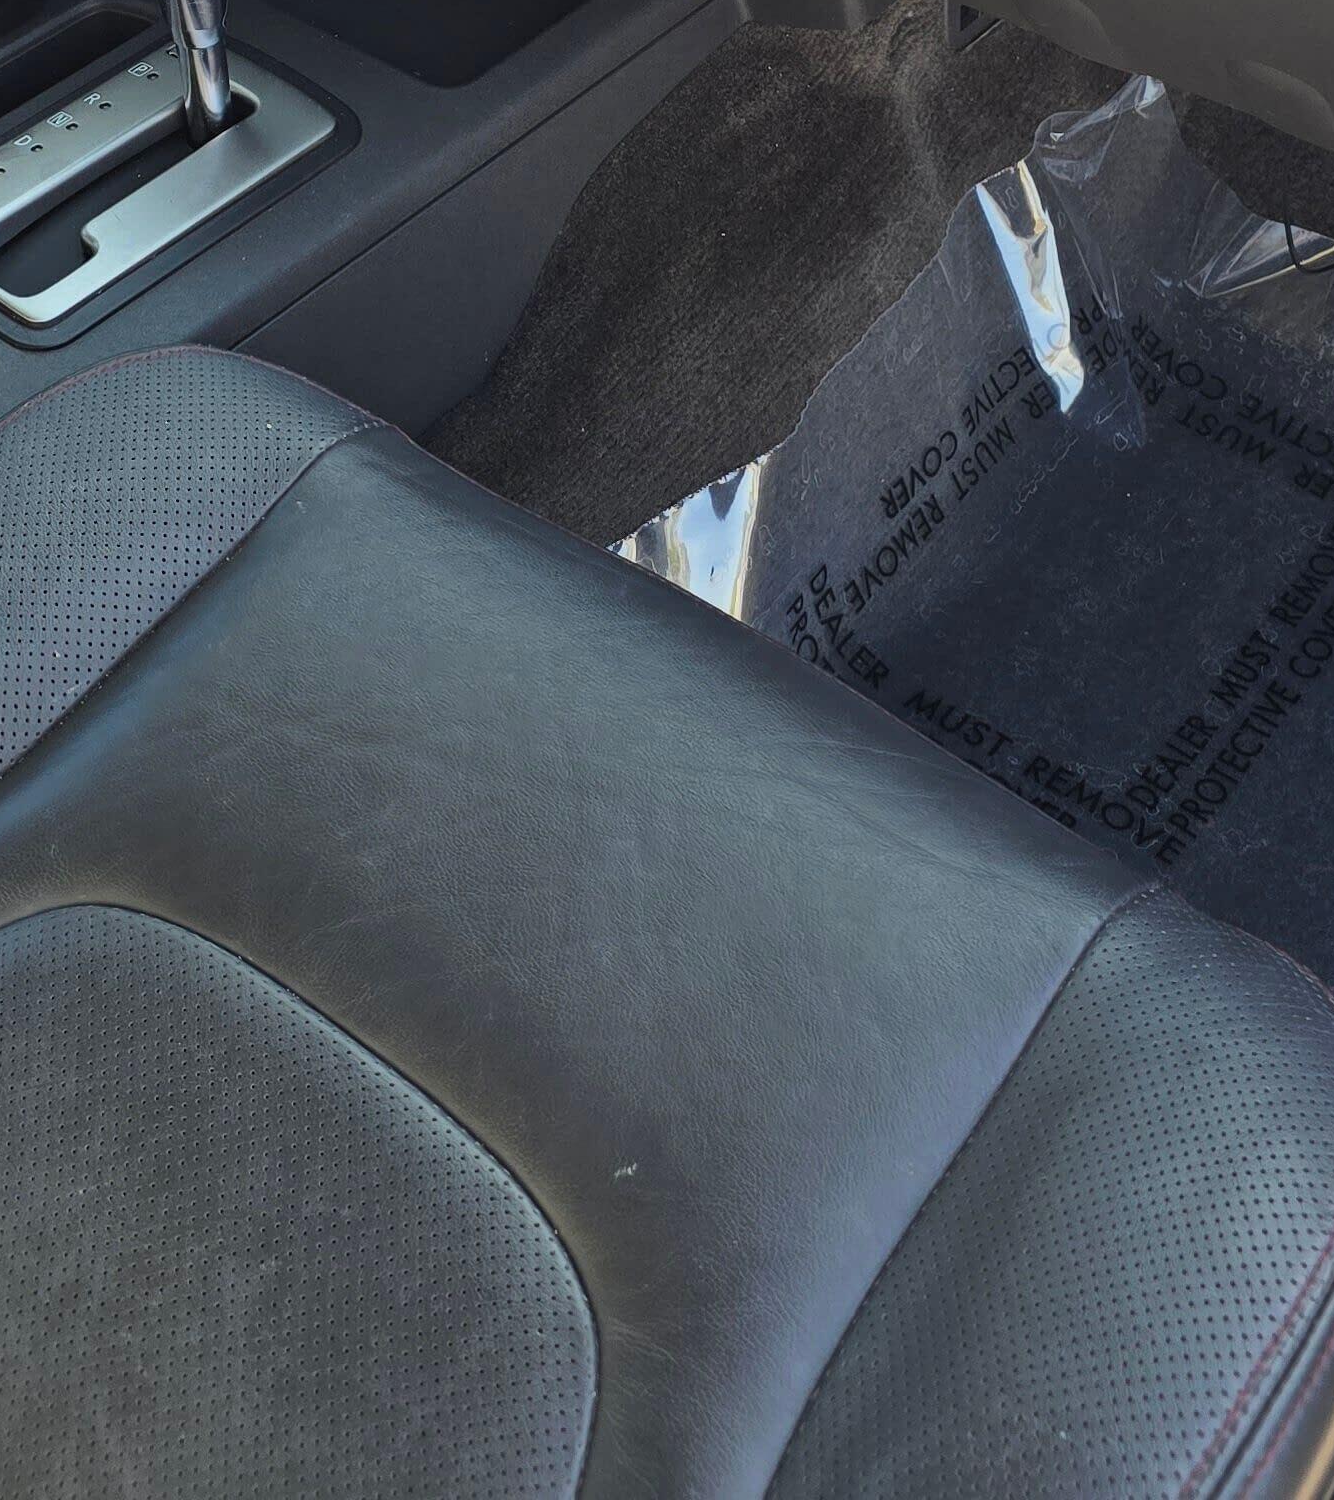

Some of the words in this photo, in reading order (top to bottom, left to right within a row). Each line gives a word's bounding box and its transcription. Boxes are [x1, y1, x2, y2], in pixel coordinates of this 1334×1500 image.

[14, 135, 32, 148] D
[83, 93, 102, 107] R
[1128, 316, 1227, 405] COVER
[877, 431, 963, 521] COVER
[950, 417, 1016, 496] MUST
[1176, 406, 1277, 465] MUST
[842, 497, 945, 610] REMOVE
[809, 563, 890, 693] DEALER
[904, 690, 1013, 761] MUST
[1126, 712, 1222, 812] DEALER
[1218, 629, 1282, 707] MUST
[1168, 674, 1302, 842] PROTECTIVE
